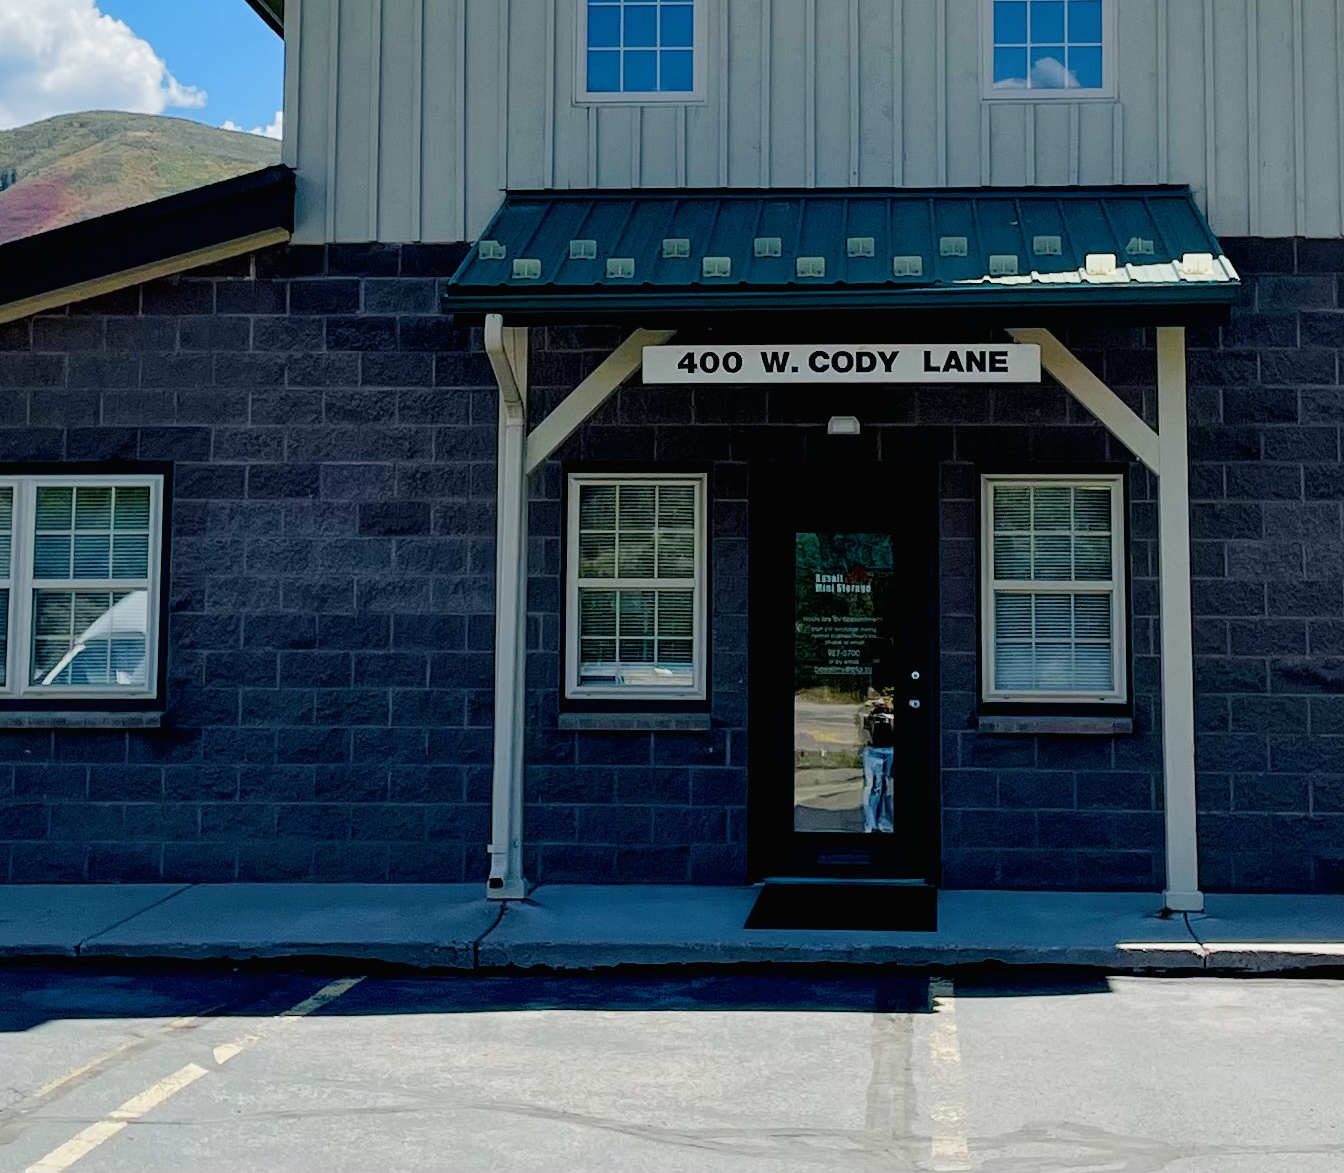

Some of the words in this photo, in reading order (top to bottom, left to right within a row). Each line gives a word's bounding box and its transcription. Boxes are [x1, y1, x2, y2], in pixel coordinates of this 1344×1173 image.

[677, 350, 743, 373] 400
[760, 350, 799, 373] W.
[808, 350, 900, 373] CODY
[923, 350, 1009, 373] LANE
